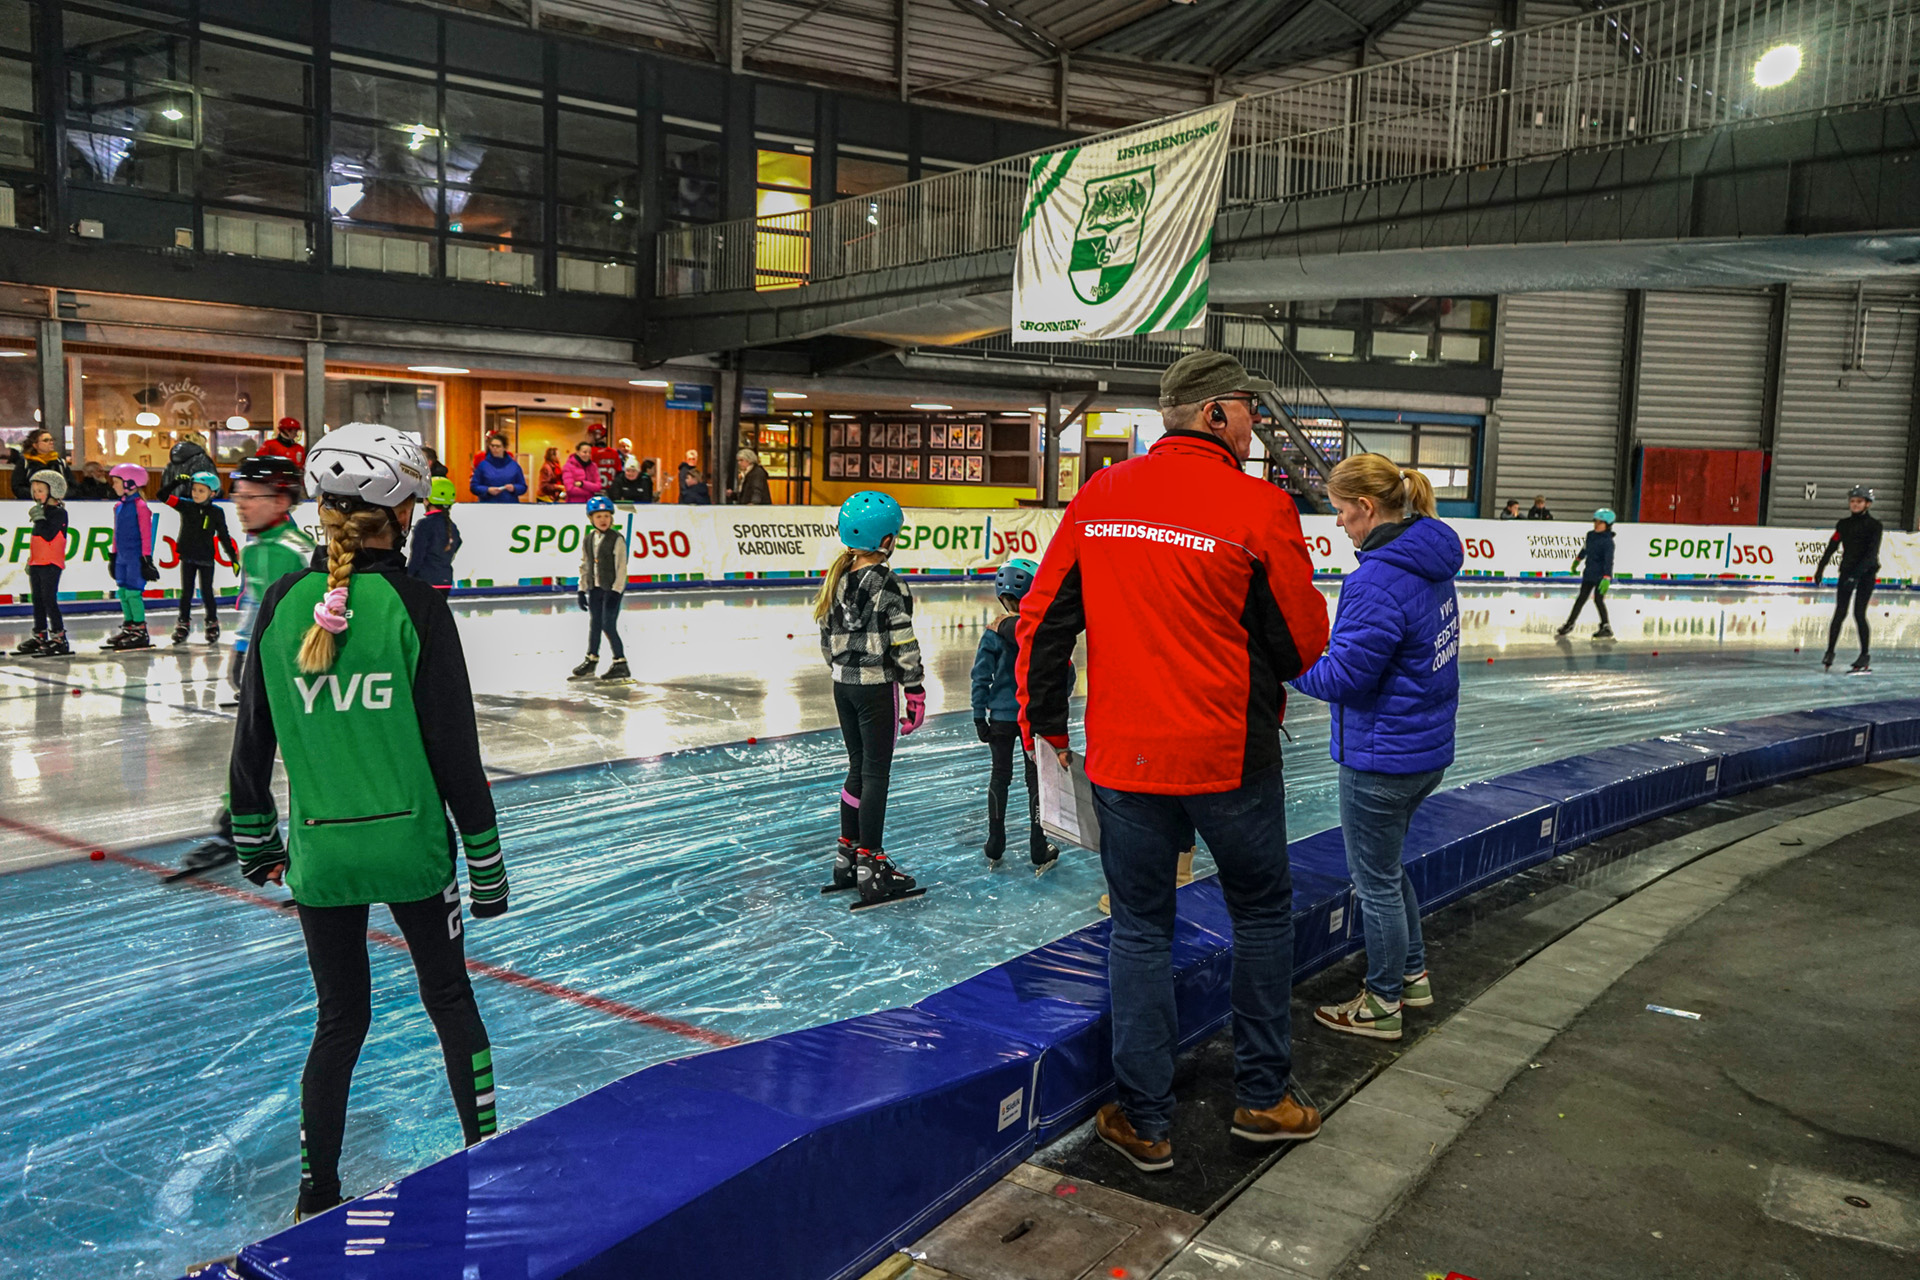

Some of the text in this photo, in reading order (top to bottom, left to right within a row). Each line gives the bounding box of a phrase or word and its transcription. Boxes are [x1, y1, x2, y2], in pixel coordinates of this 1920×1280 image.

[733, 524, 840, 538] SPORTCENTRUM
[895, 525, 984, 550] SPORT
[1084, 523, 1217, 553] SCHEIDSRECHTER
[1526, 535, 1586, 547] SPORTCENT
[737, 541, 806, 555] KARDINGE
[1648, 538, 1725, 560] SPORT
[1440, 597, 1453, 620] YVG
[293, 673, 393, 714] YVG
